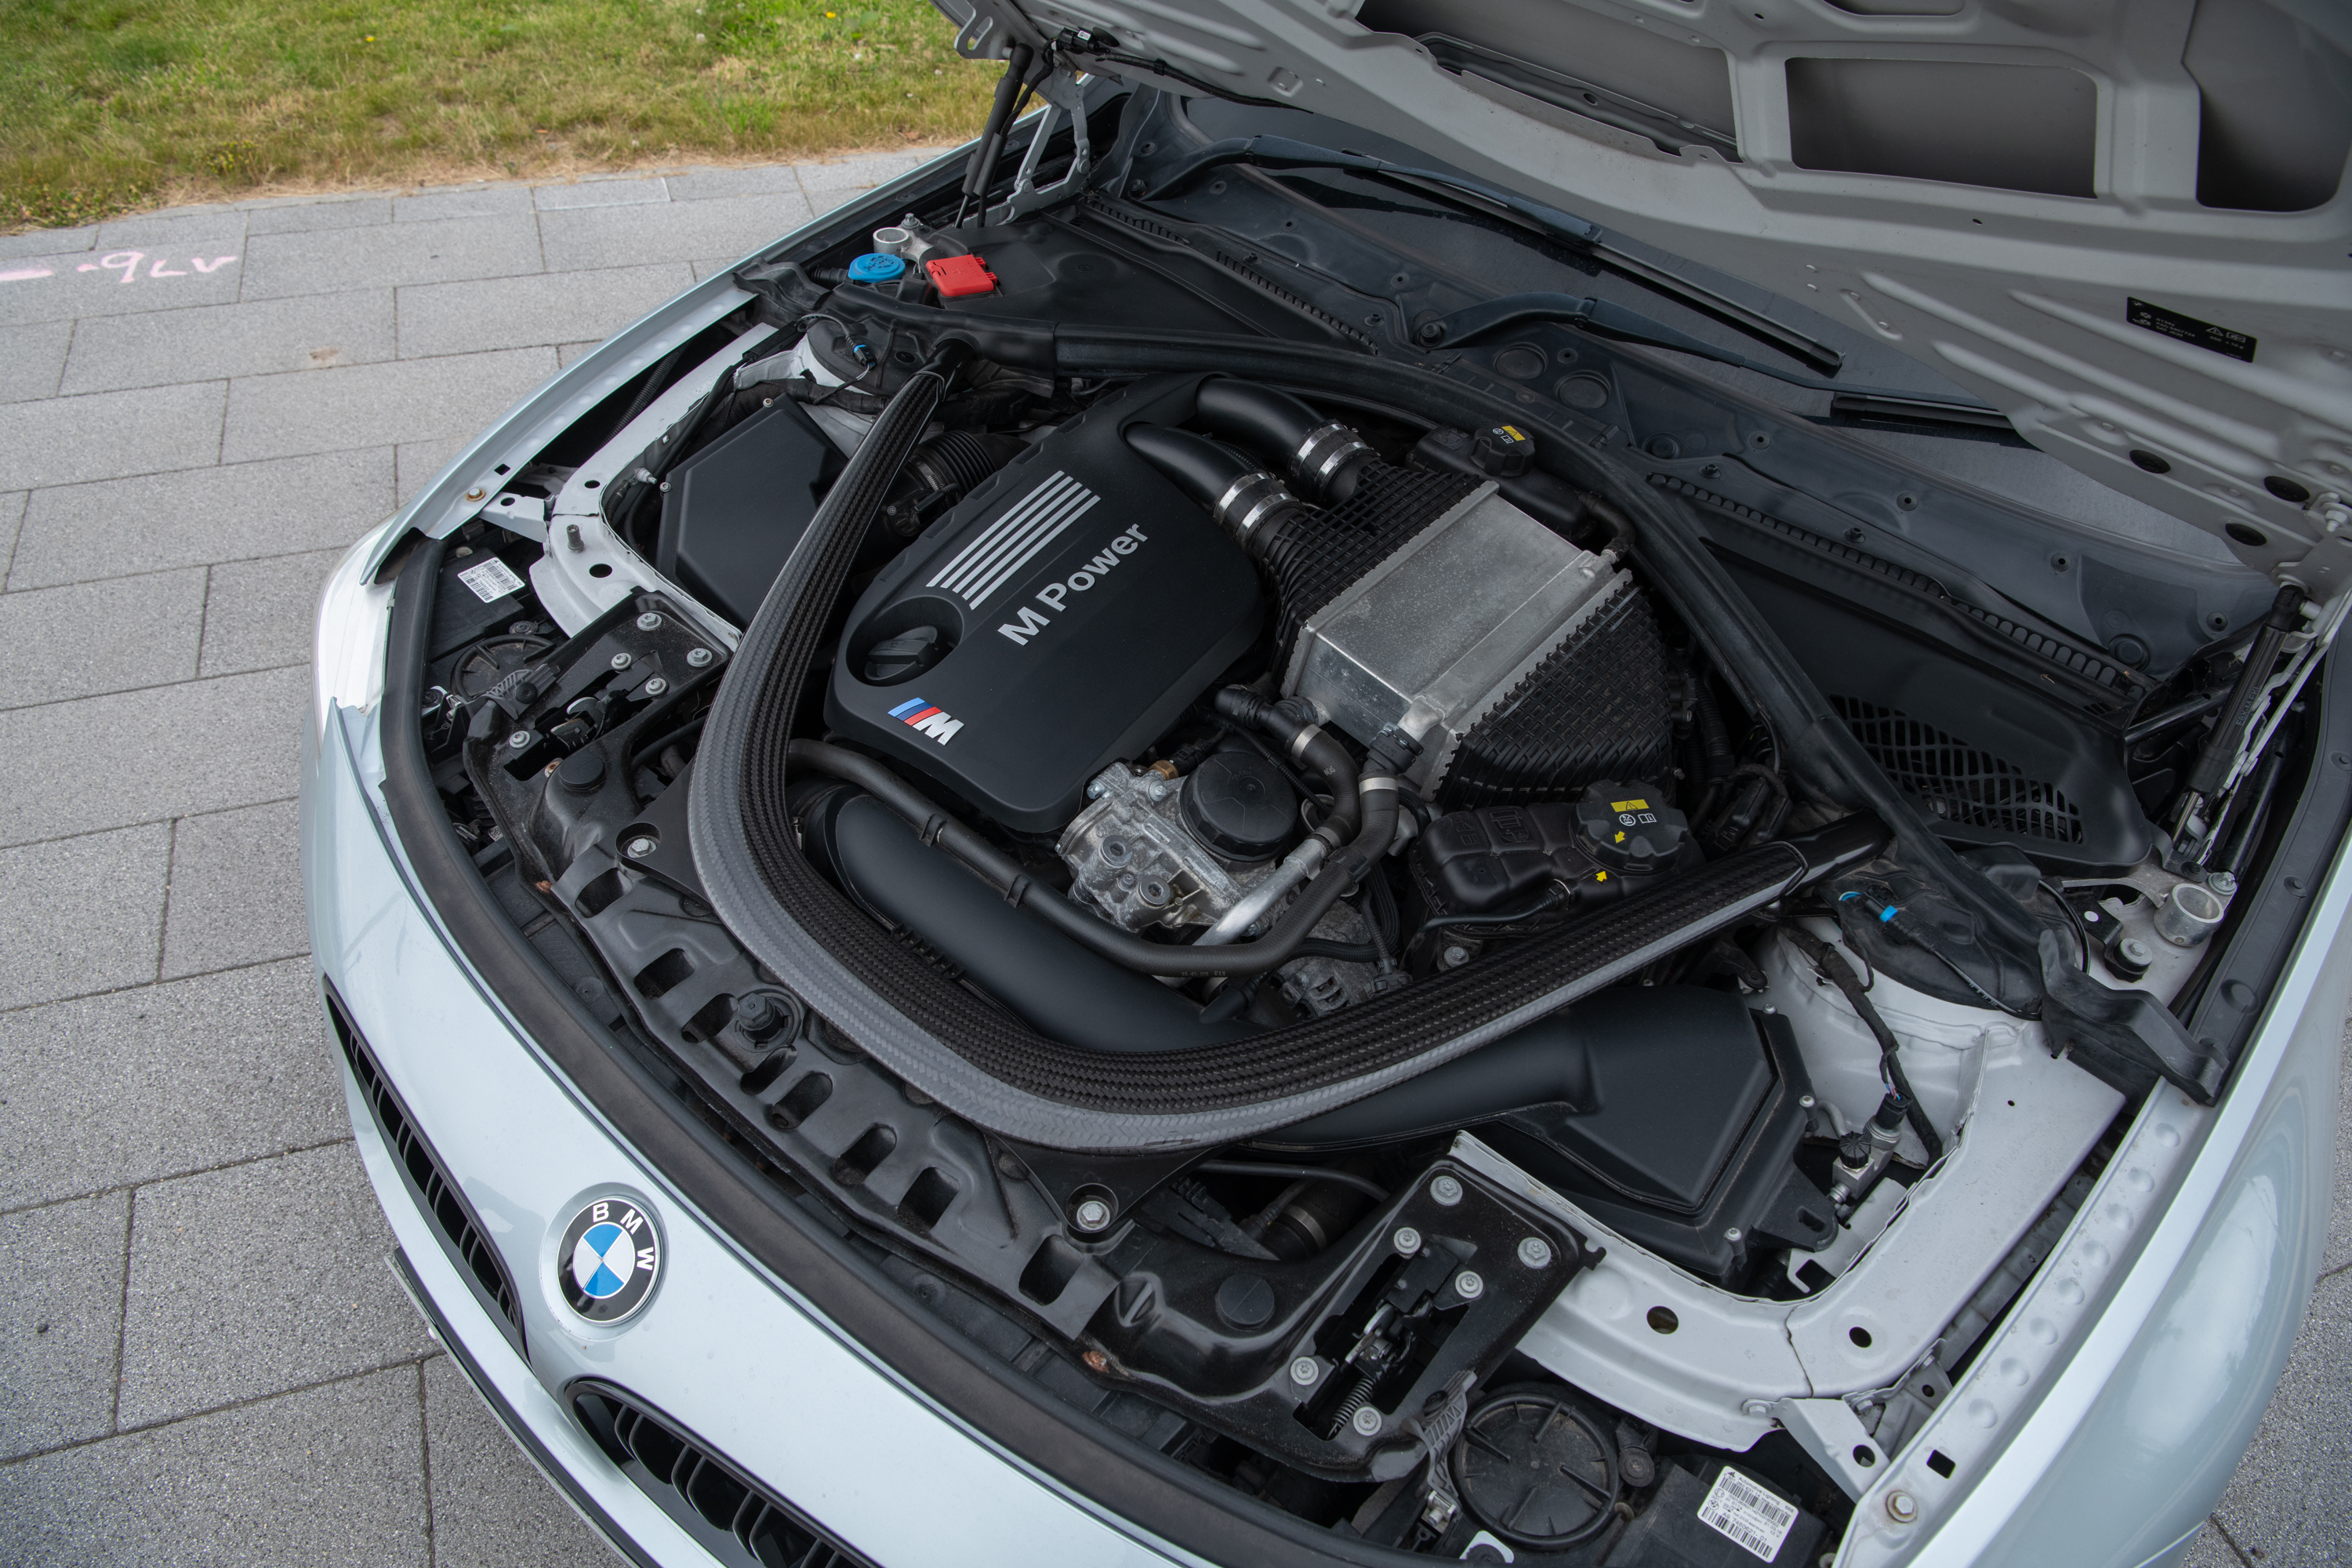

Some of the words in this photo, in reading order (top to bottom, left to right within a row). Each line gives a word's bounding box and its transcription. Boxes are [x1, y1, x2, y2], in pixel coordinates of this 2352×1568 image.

[997, 606, 1051, 646] M
[1035, 523, 1149, 612] Power
[593, 1202, 655, 1271] BMW
[1738, 1477, 1762, 1494] Automotive
[1762, 1492, 1780, 1505] Lighting
